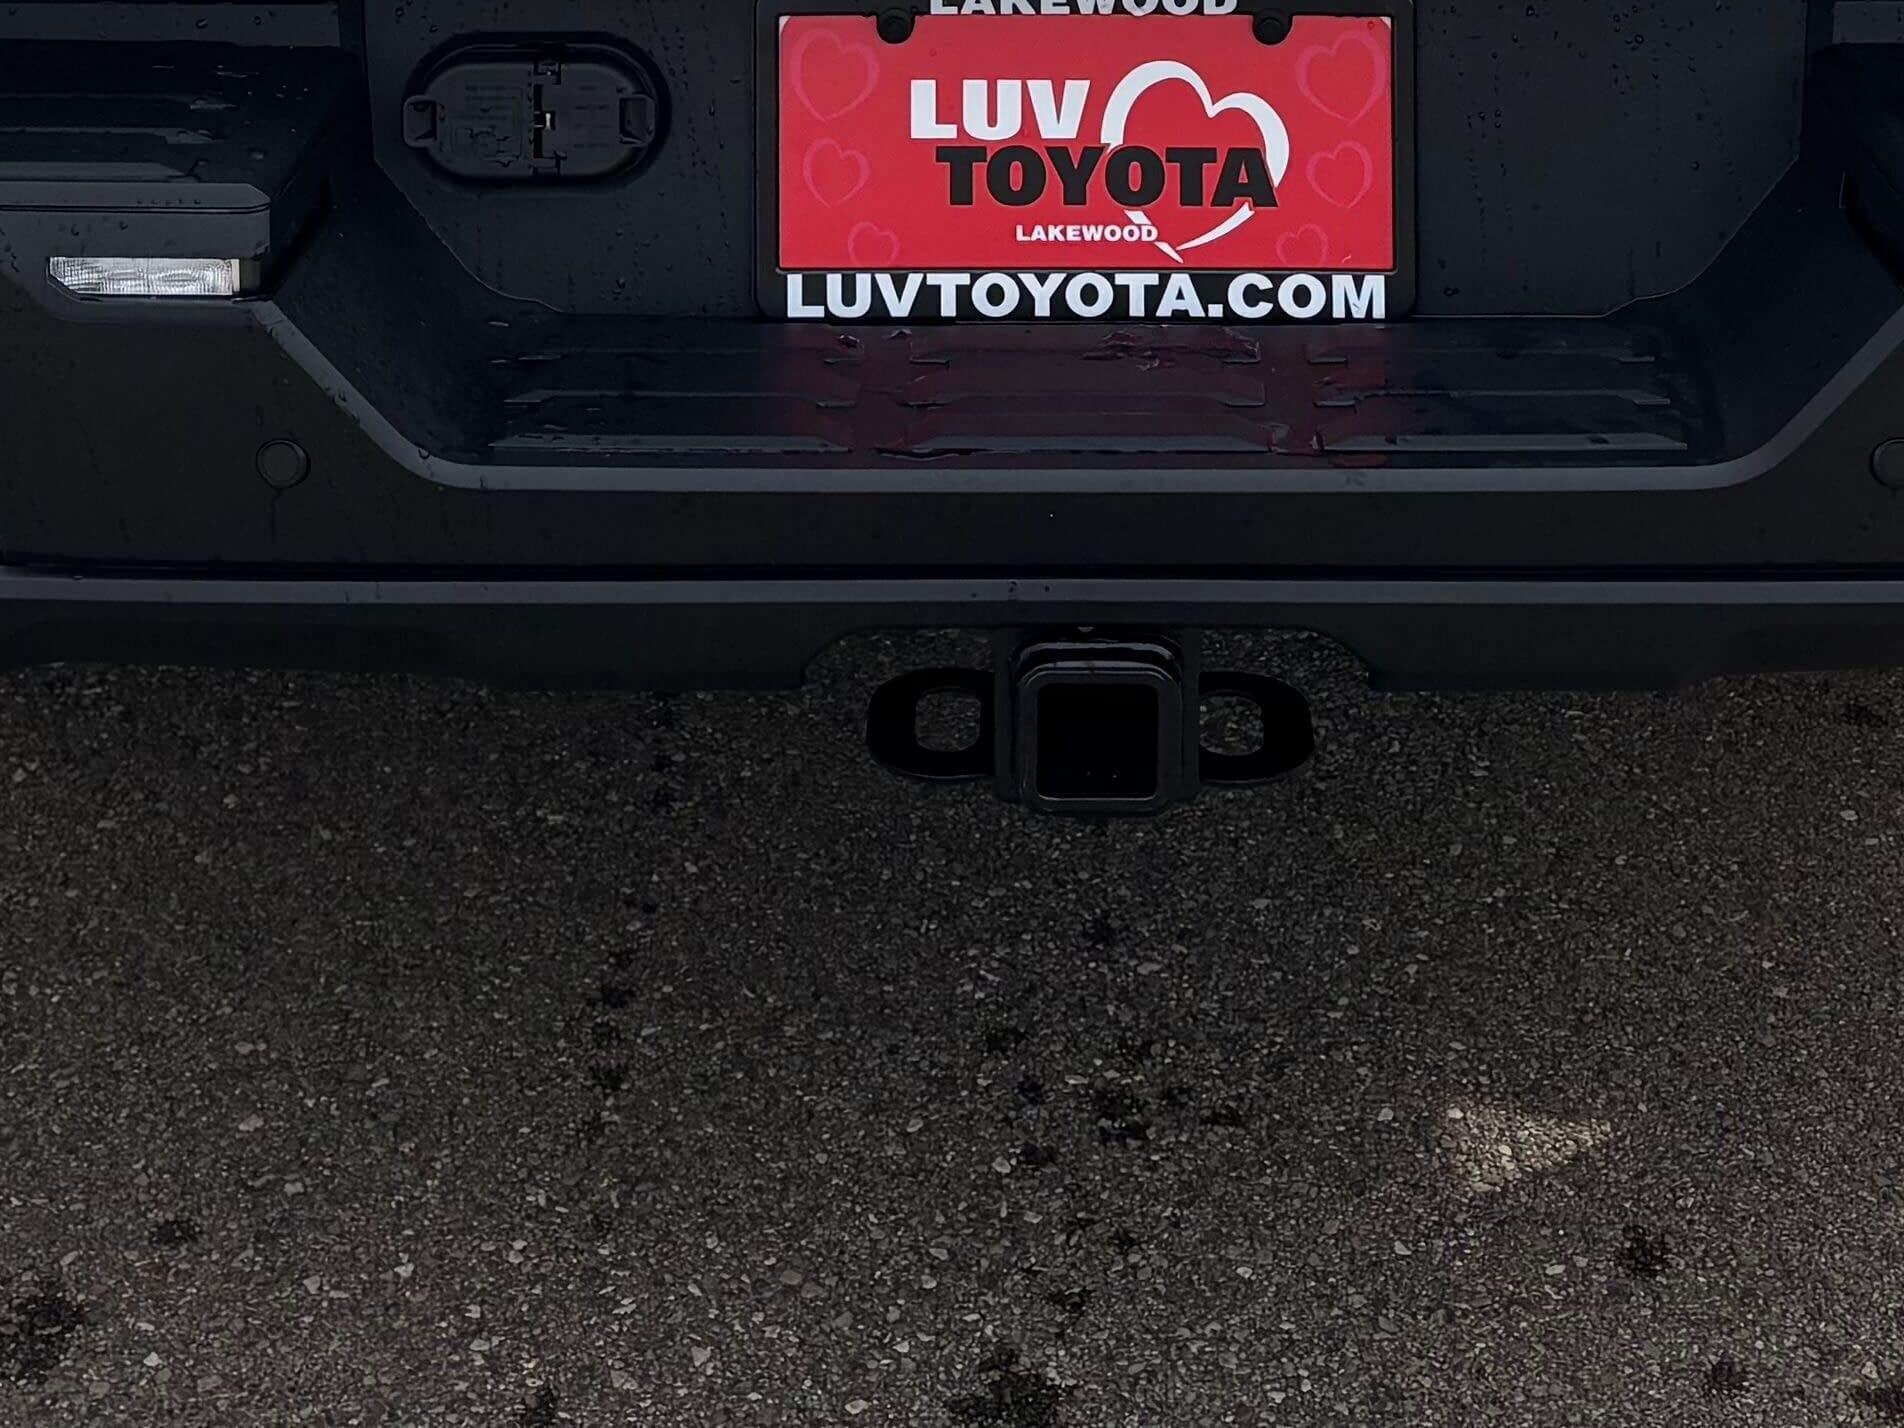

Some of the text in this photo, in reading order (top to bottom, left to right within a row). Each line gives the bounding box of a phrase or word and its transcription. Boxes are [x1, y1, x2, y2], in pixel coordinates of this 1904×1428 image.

[909, 79, 1091, 141] LUV
[935, 144, 1278, 208] TOYOTA
[1015, 224, 1159, 243] LAKEWOOD
[786, 272, 1387, 319] LUVTOYOTA.COM
